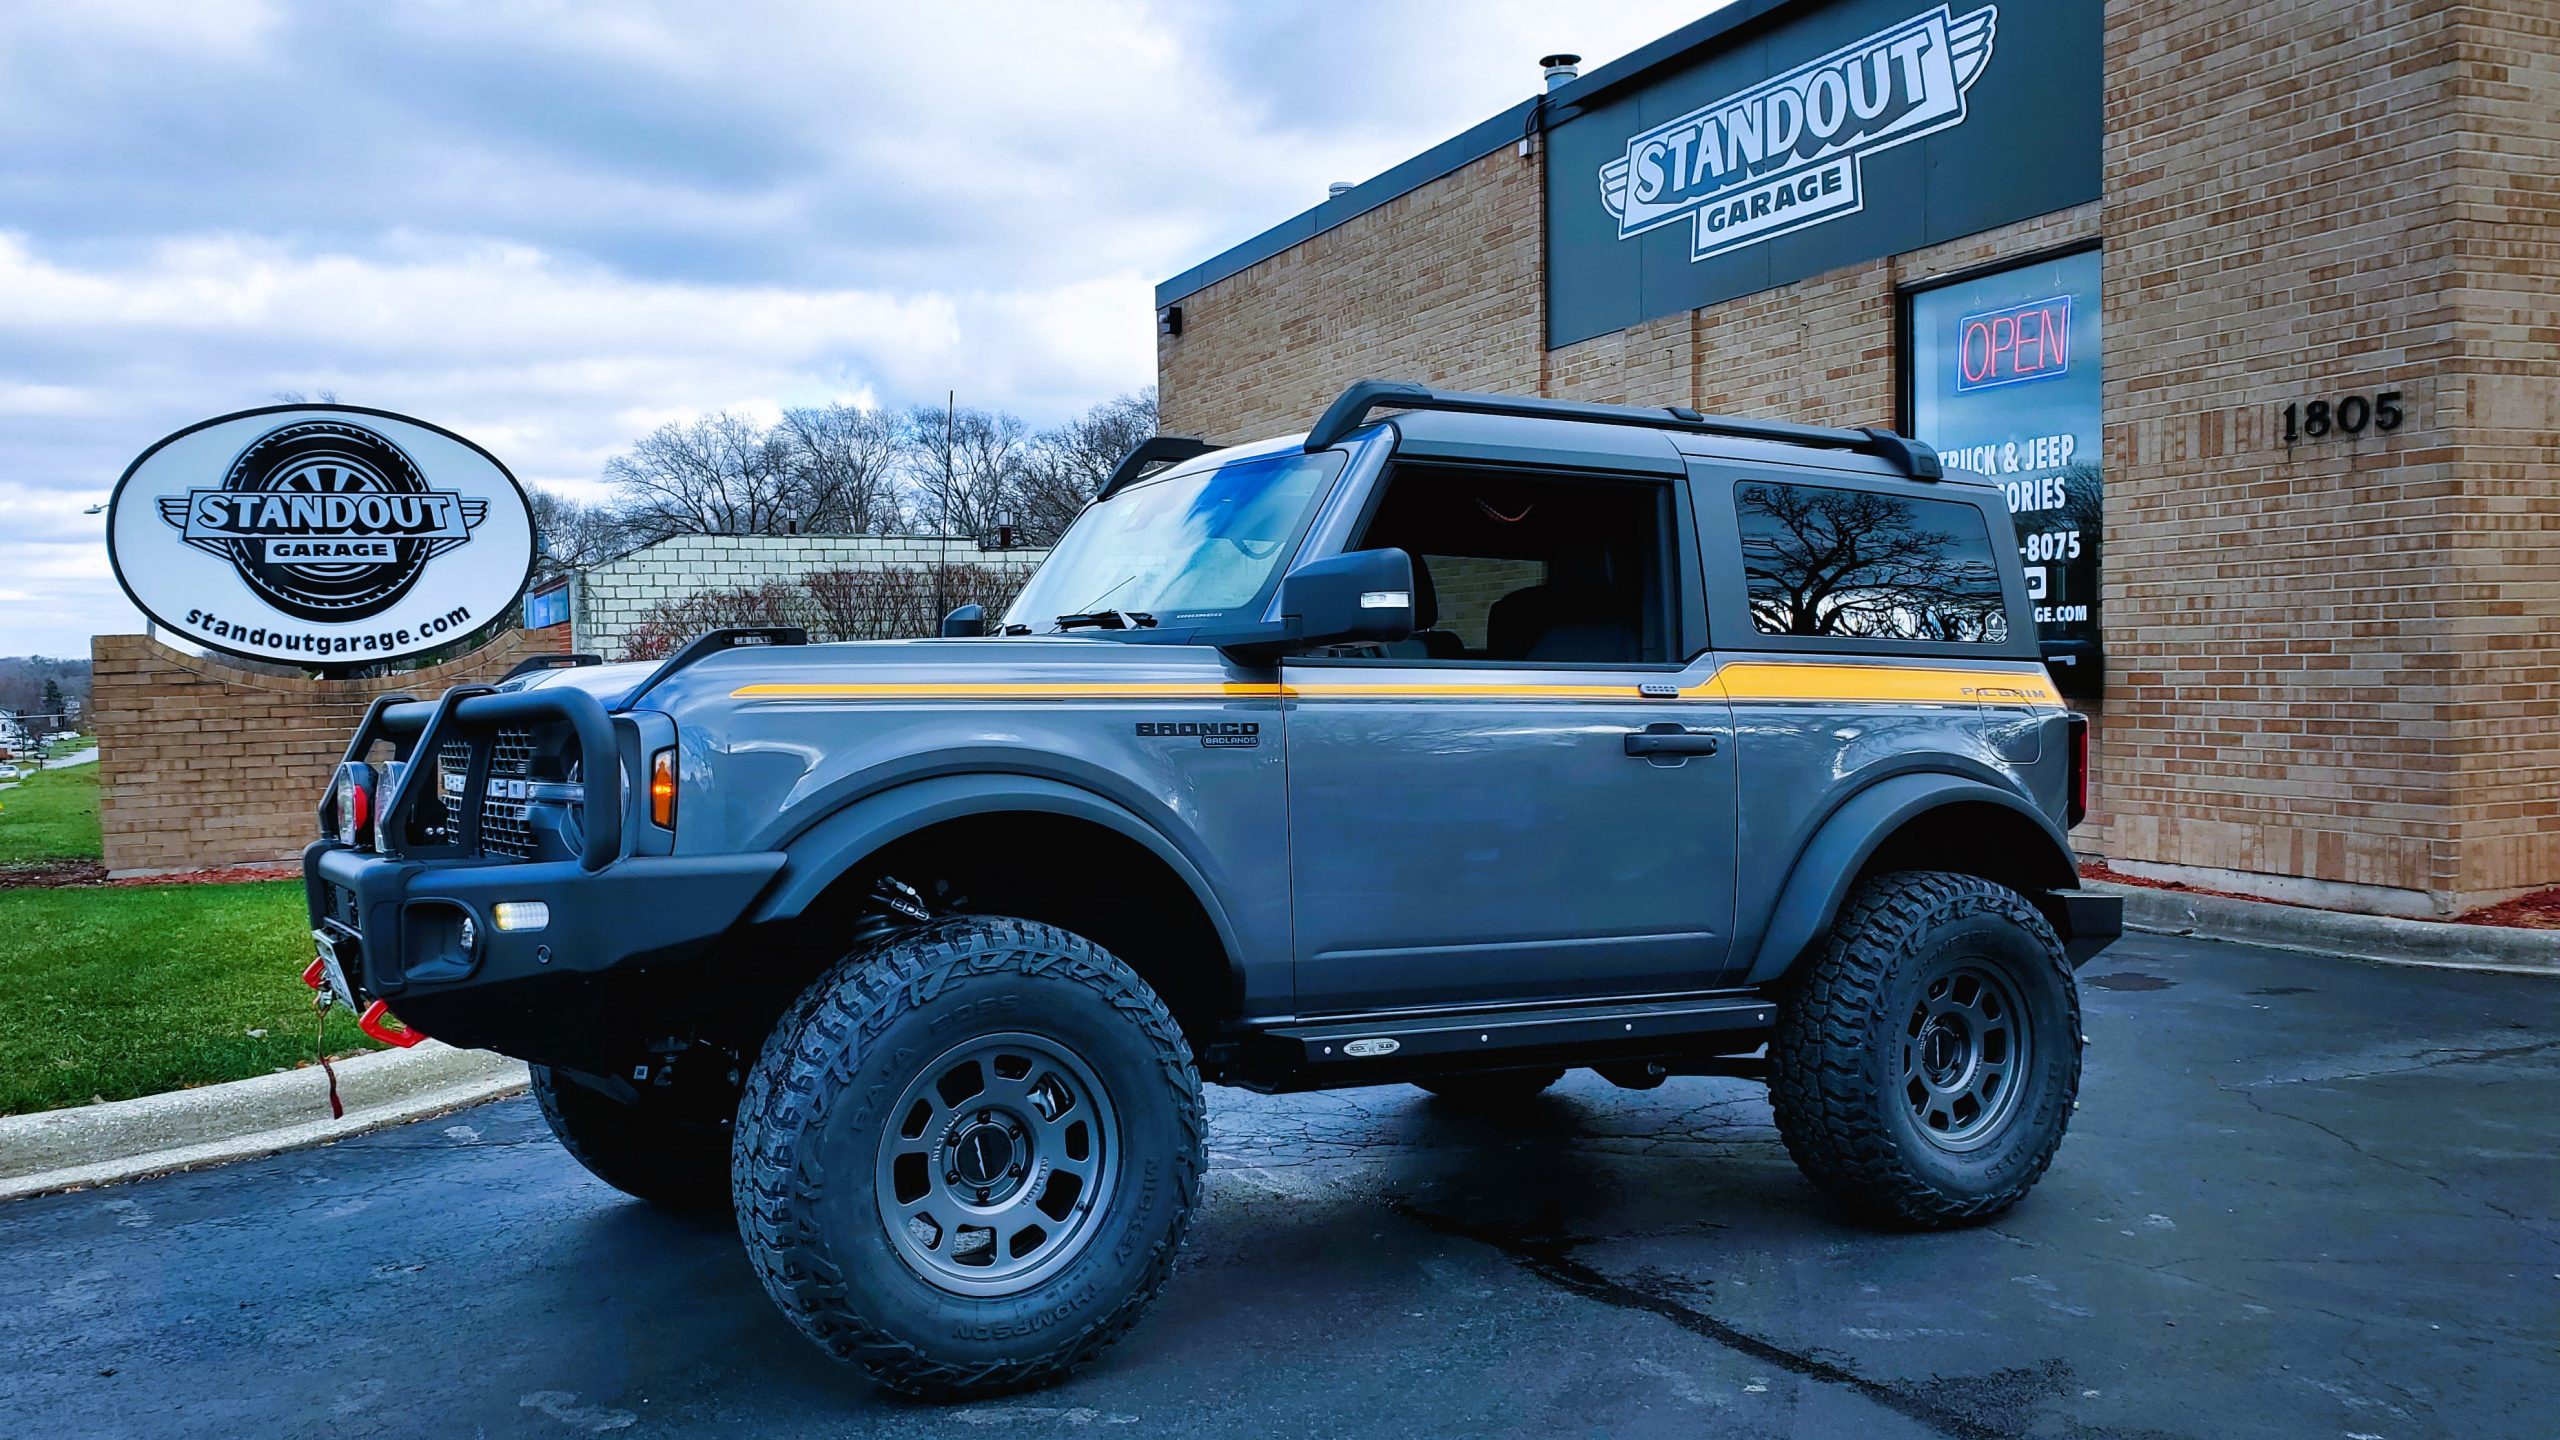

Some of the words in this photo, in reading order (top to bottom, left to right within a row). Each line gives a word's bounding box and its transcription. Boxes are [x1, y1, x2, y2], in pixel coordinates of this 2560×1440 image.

[1636, 30, 1932, 202] STANDOUT
[1706, 166, 1842, 233] GARAGE
[1963, 304, 2067, 382] OPEN
[2283, 391, 2403, 441] 1805
[2003, 442, 2019, 474] &
[2025, 434, 2074, 471] JEEP
[196, 494, 451, 533] STANDOUT
[1997, 476, 2066, 514] ORIES
[272, 542, 389, 558] GARAGE
[185, 603, 472, 656] standoutgarage.com
[1959, 687, 2047, 699] PILGRIM
[1135, 722, 1260, 737] BRONCO
[1205, 736, 1258, 745] BADLANDS
[952, 1280, 1106, 1341] THOMPSON
